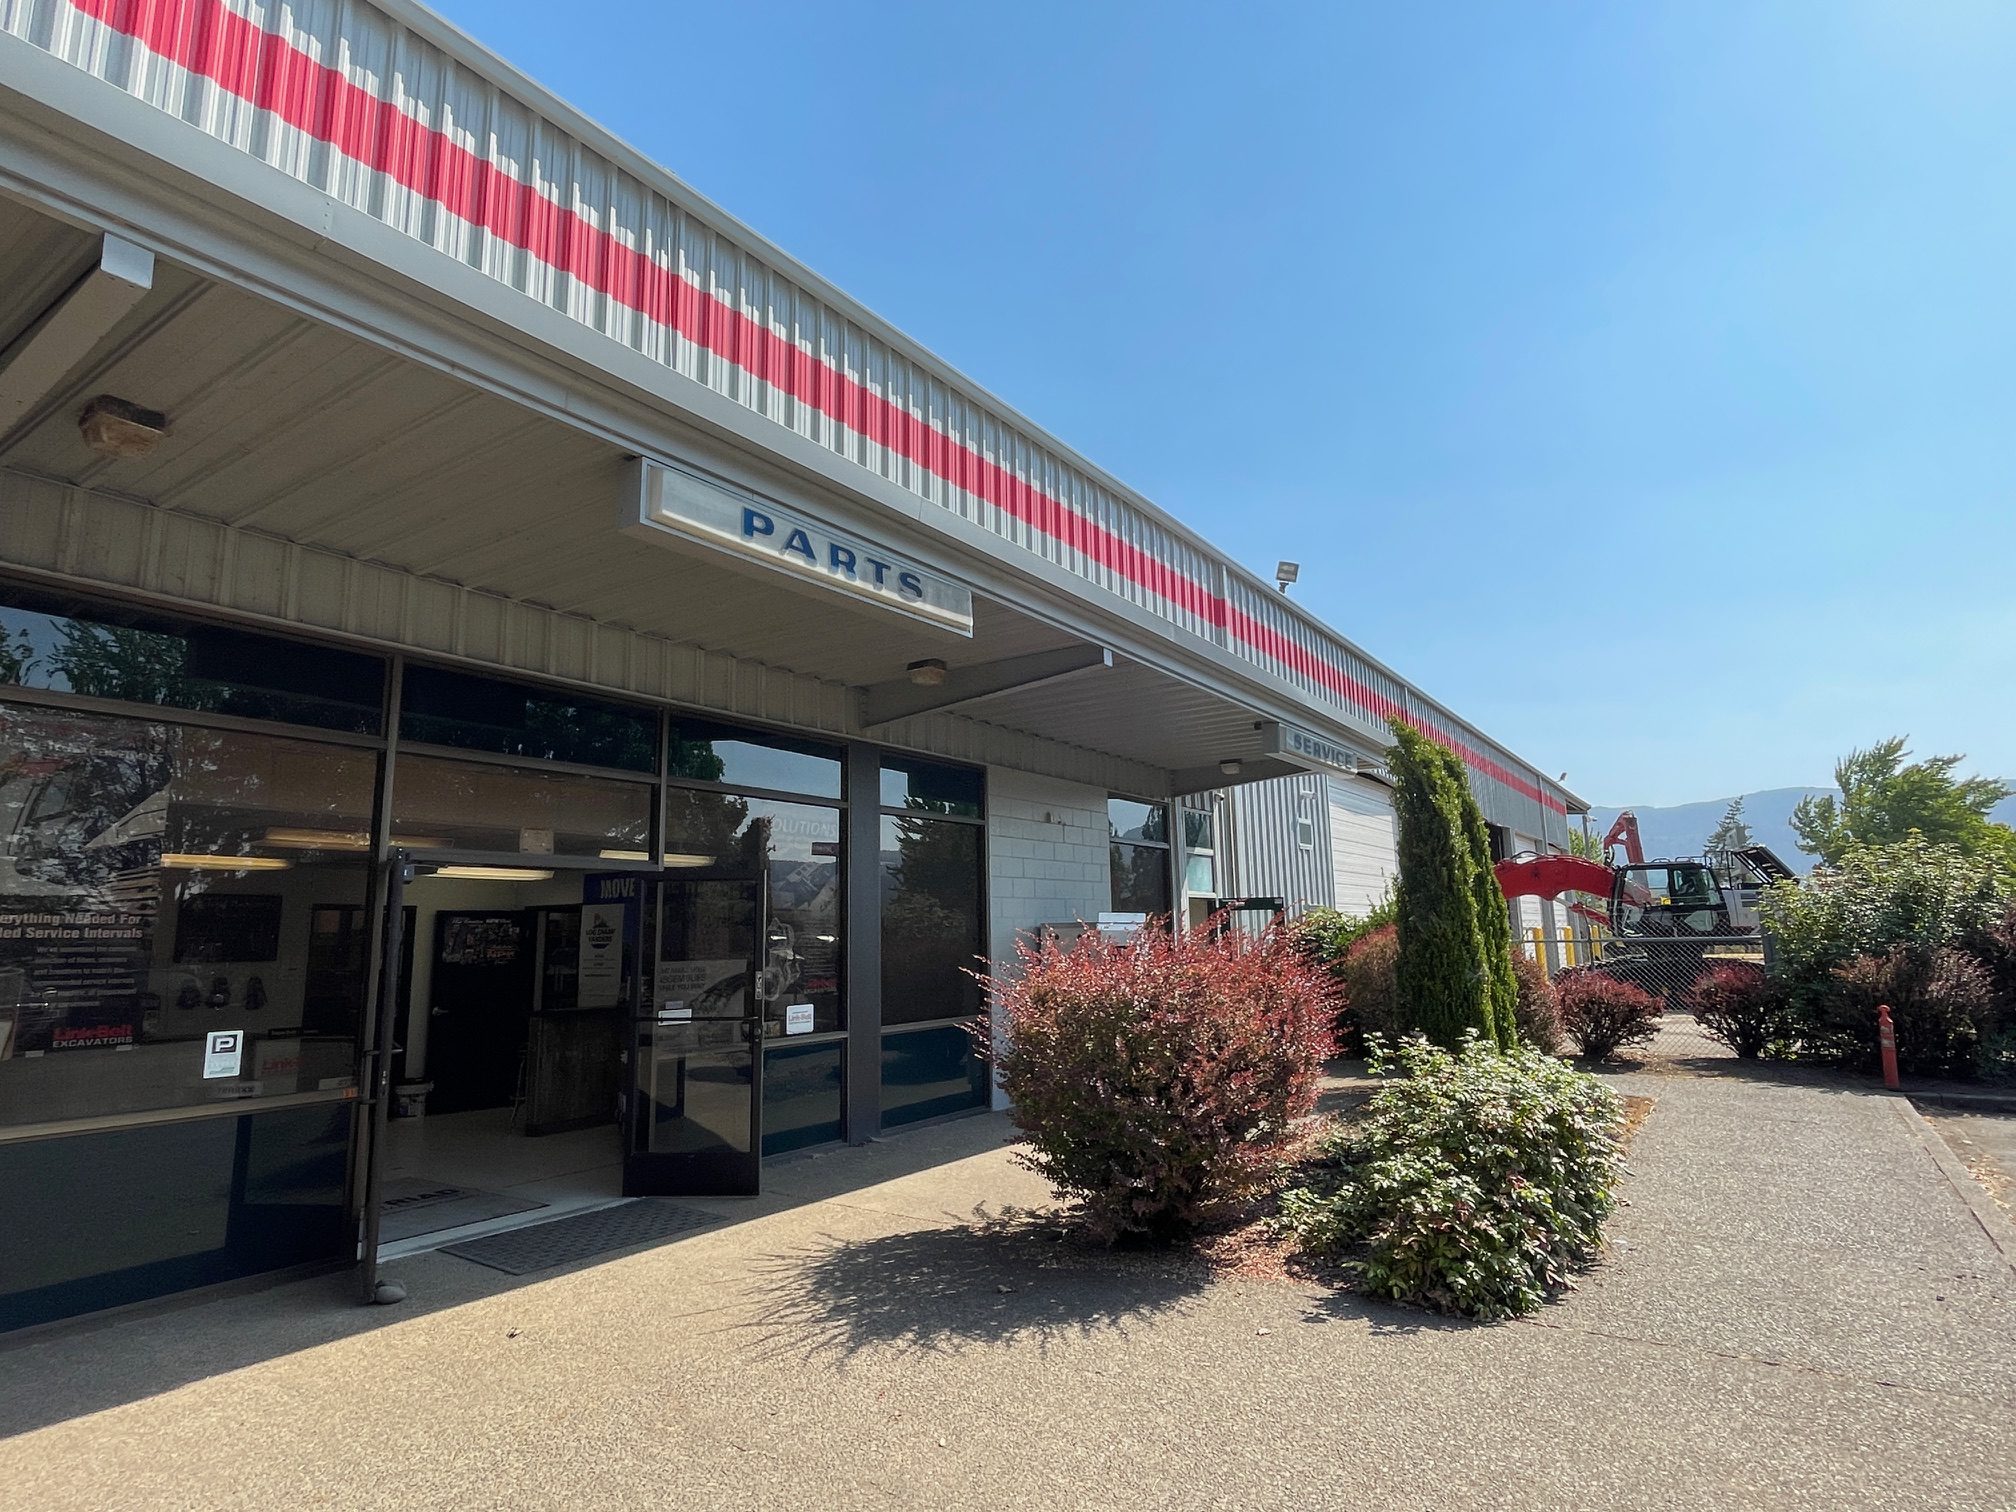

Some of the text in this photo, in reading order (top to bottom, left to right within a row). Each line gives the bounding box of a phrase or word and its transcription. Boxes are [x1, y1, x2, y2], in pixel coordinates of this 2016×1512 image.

[741, 506, 924, 600] PARTS
[1292, 734, 1353, 769] SERVICE
[770, 817, 837, 838] OLUTIONS
[600, 877, 636, 899] MOVE
[65, 912, 116, 924] Needed
[120, 913, 142, 924] For
[25, 926, 80, 939] Service
[84, 926, 144, 939] Intervals
[52, 1036, 134, 1049] EXCAVATORS
